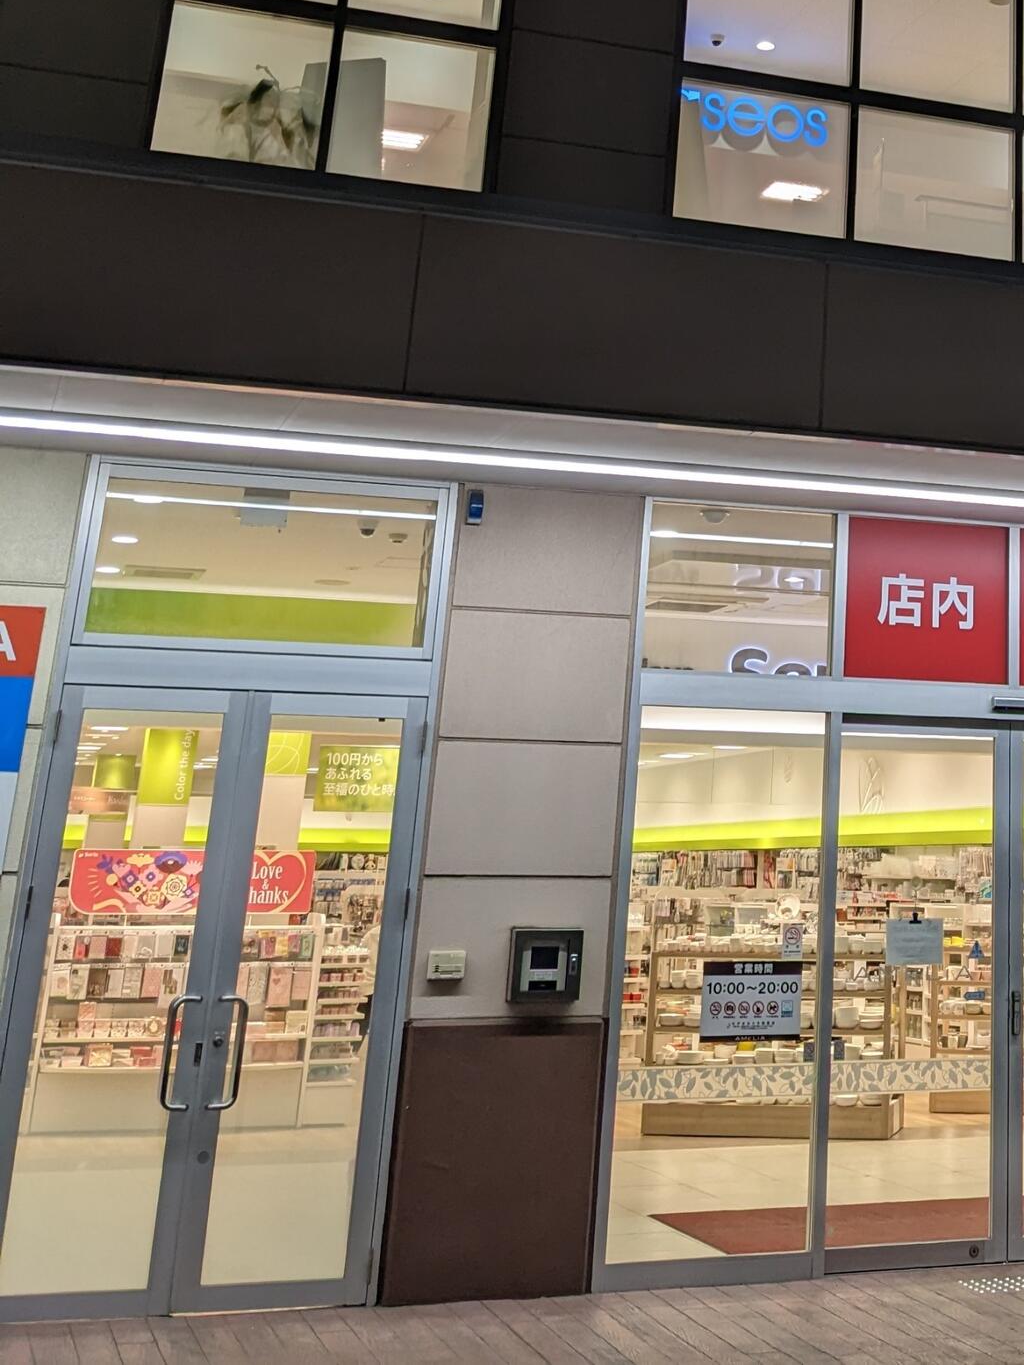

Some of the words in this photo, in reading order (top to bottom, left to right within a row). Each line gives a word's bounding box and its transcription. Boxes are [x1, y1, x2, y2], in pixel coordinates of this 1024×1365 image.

[877, 572, 975, 631] 店内
[178, 751, 190, 768] the
[327, 752, 384, 766] 100円から
[325, 767, 372, 780] あふれる
[174, 771, 187, 801] Color
[251, 861, 283, 880] Love
[262, 878, 270, 890] &
[248, 886, 289, 904] hanks
[734, 963, 774, 974] 営業時間
